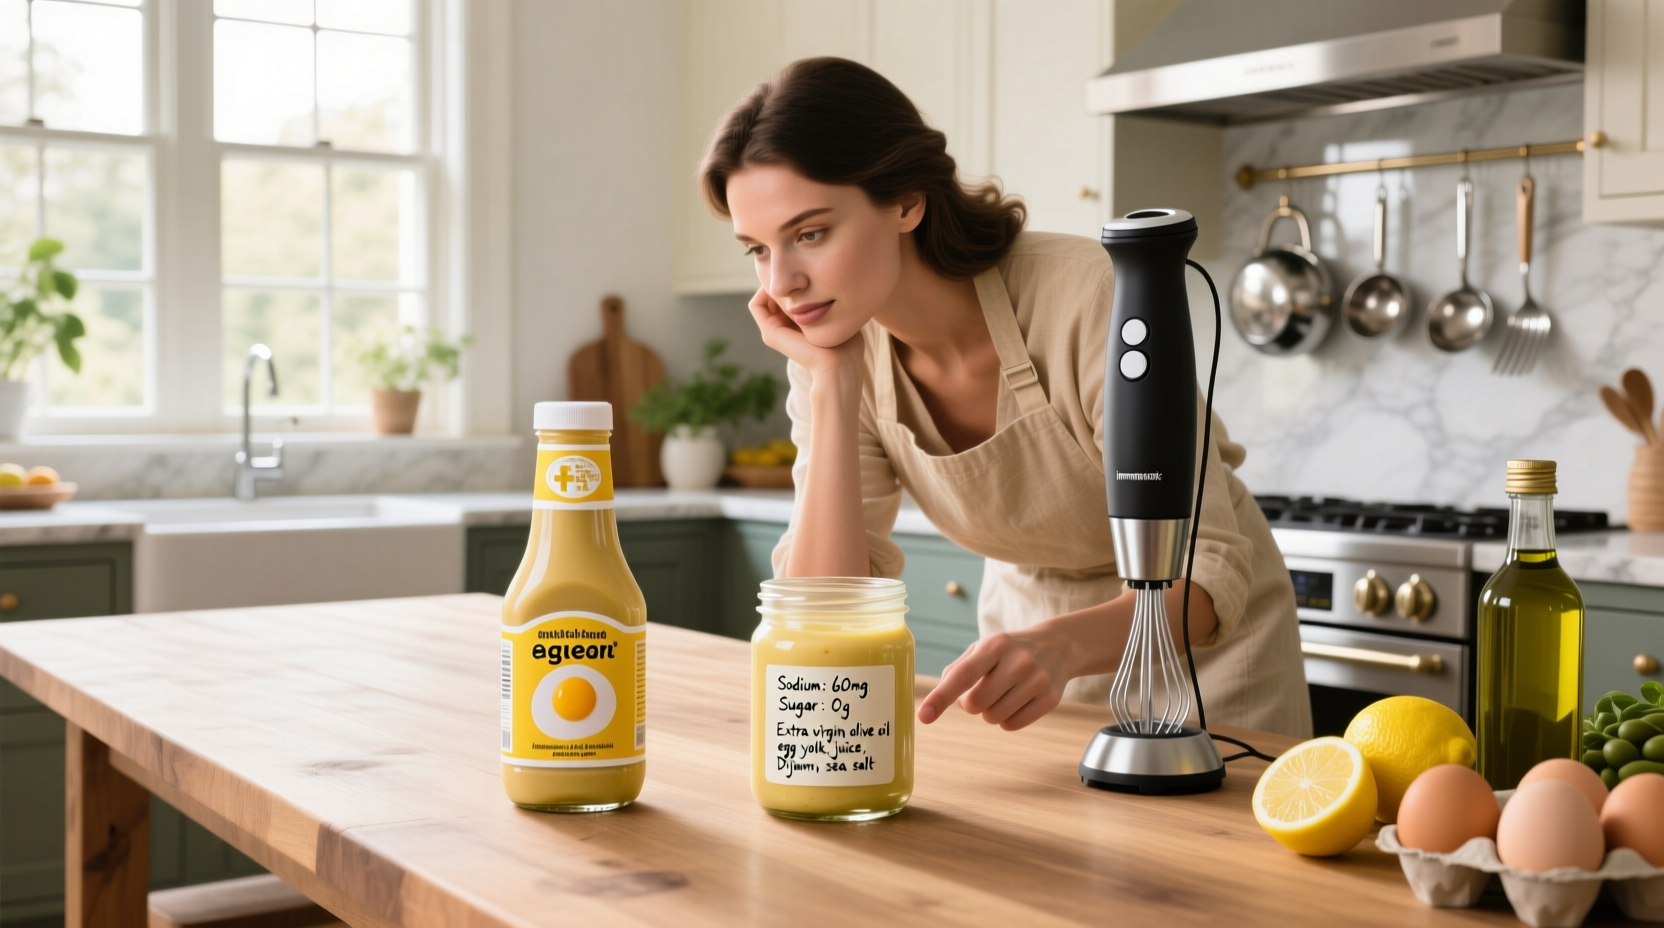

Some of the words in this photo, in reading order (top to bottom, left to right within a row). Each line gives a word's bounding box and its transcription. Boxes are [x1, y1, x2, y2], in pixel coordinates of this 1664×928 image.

[777, 675, 826, 691] Sodium:
[832, 675, 869, 699] 60mg
[778, 696, 825, 718] Sugar:
[831, 698, 850, 720] 0g
[777, 722, 809, 737] Extra
[813, 725, 846, 743] virgin
[849, 722, 875, 737] olive
[777, 743, 797, 759] egg
[828, 741, 867, 760] juice,
[825, 762, 848, 772] sea
[852, 755, 876, 771] salt
